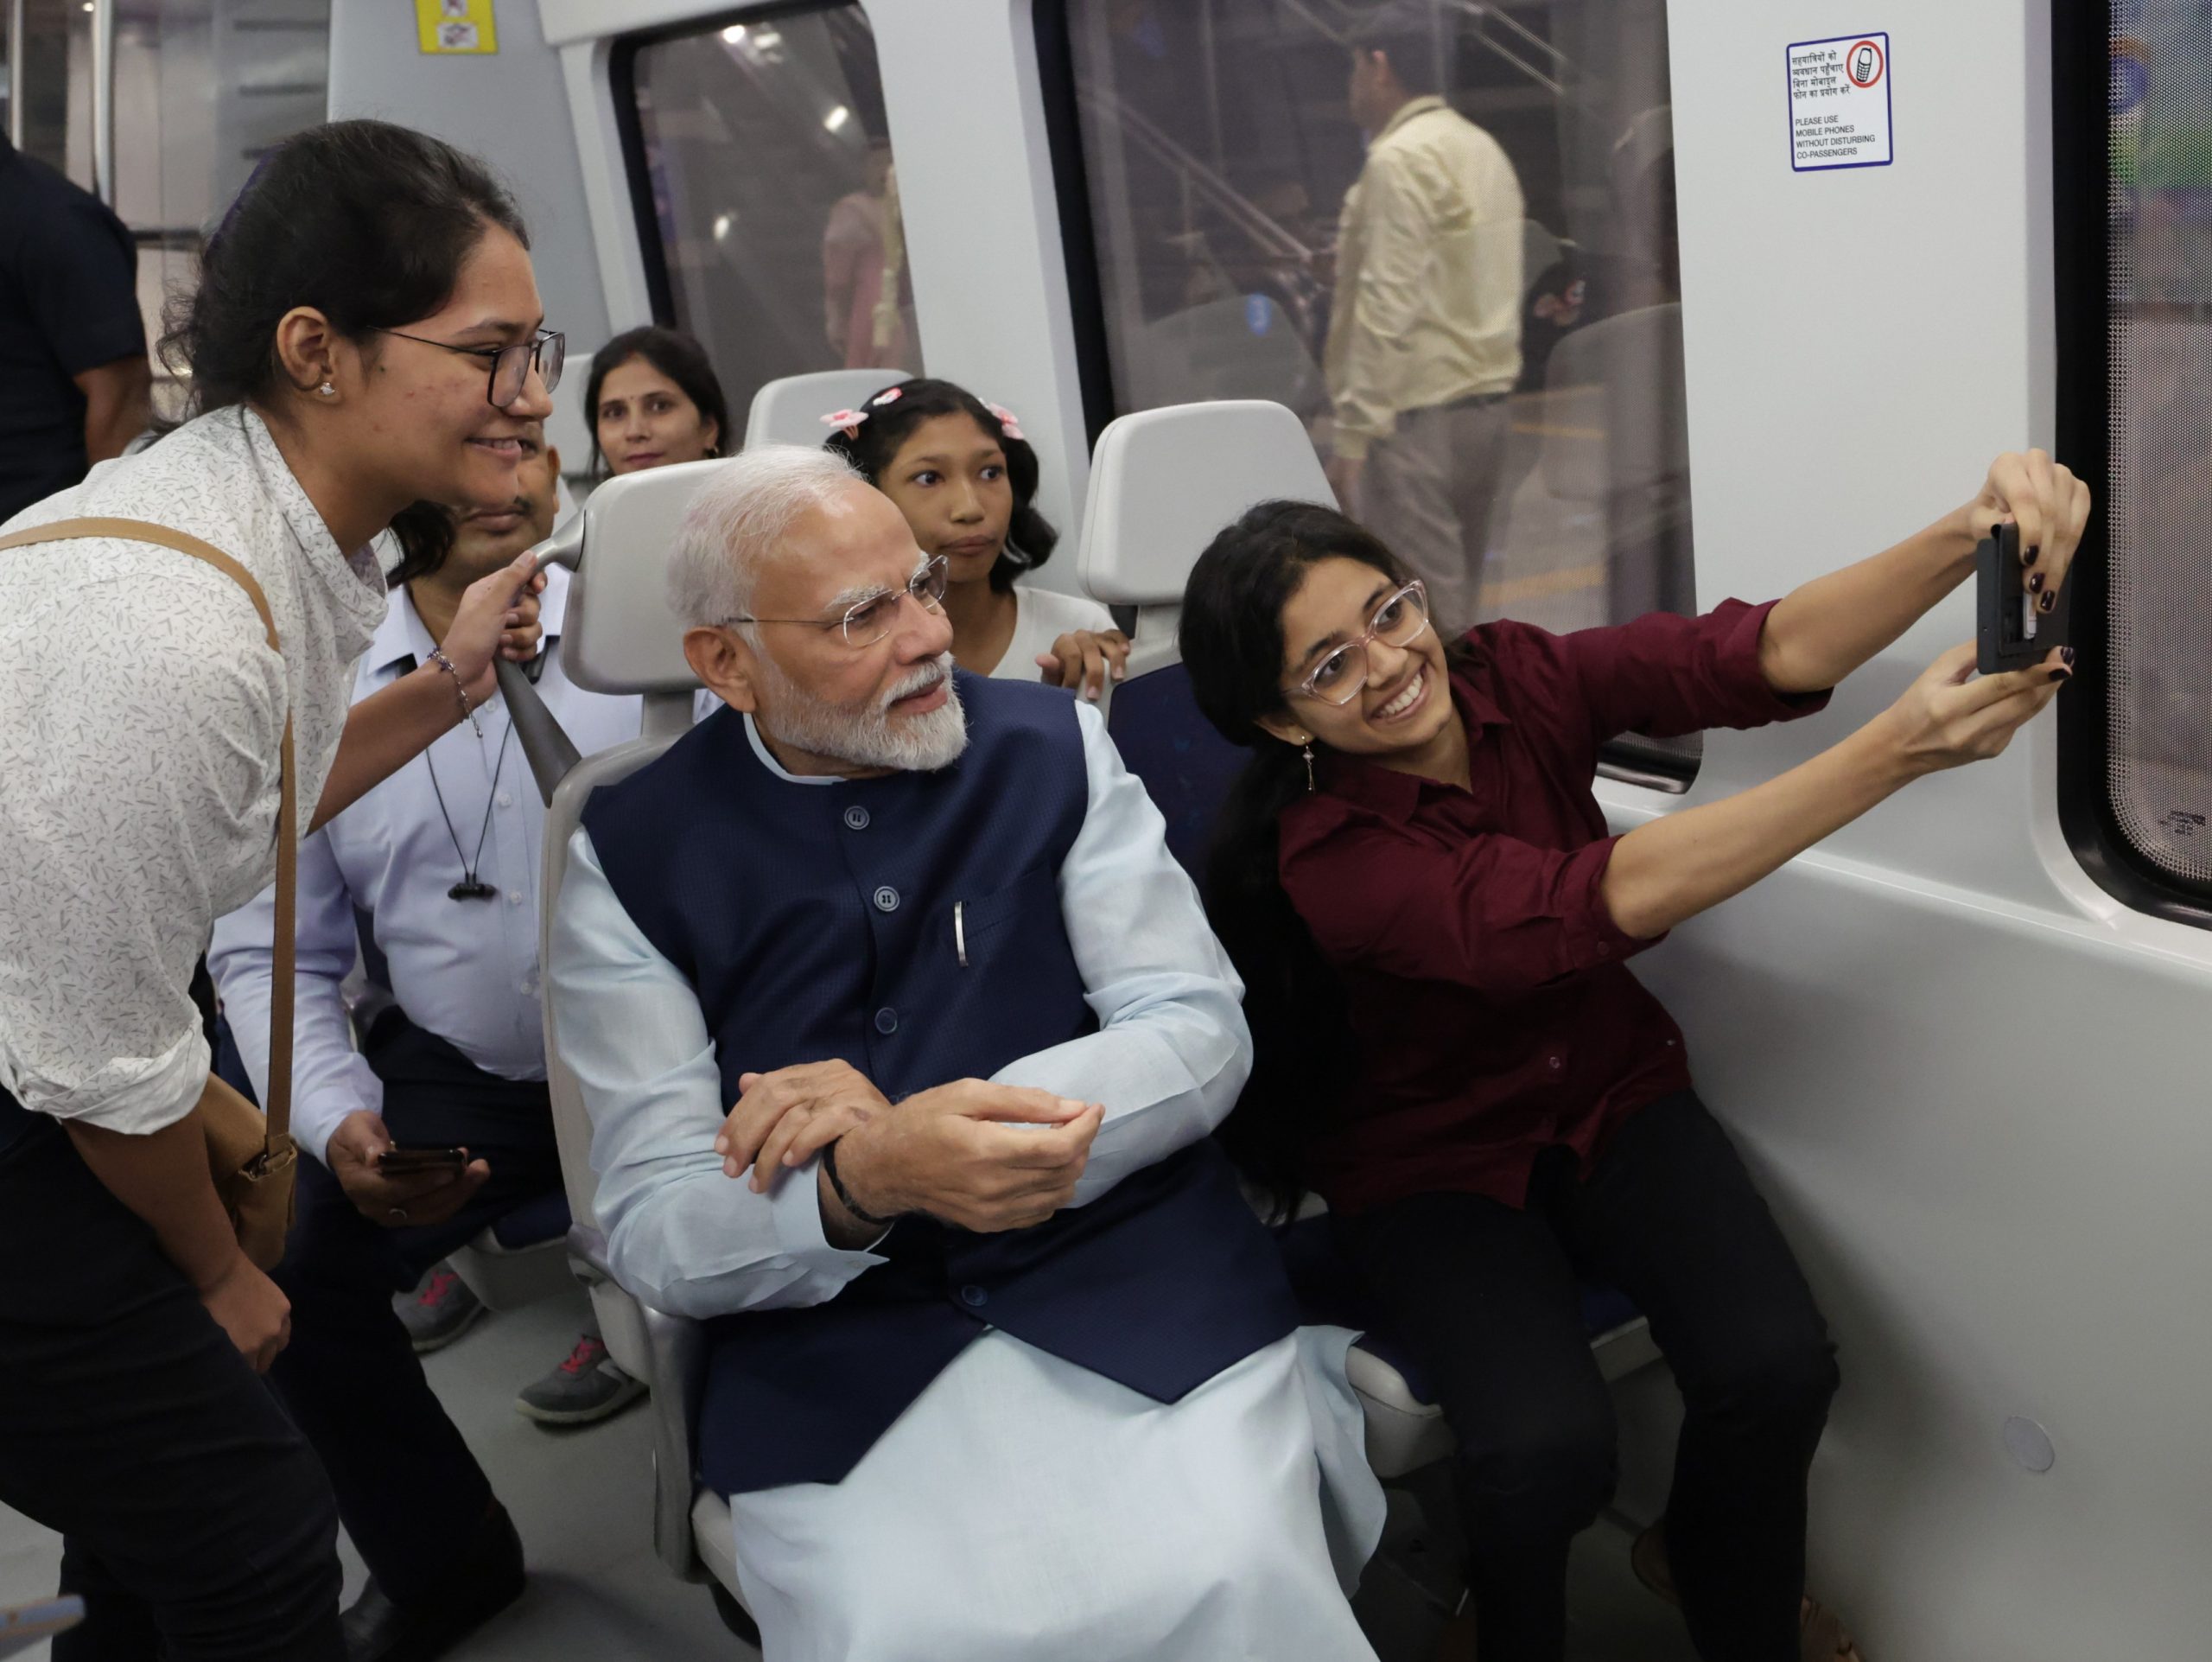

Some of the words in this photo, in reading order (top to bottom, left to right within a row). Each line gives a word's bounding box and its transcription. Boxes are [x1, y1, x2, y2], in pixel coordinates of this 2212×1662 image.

[1828, 50, 1836, 60] को
[1792, 67, 1818, 76] व्यवधान
[1792, 78, 1808, 88] बिना
[1811, 76, 1836, 86] मोबाइल
[1793, 89, 1807, 99] फोन
[1820, 86, 1838, 97] प्रयोग
[1840, 84, 1850, 94] करें
[1796, 116, 1822, 126] PLEASE
[1824, 115, 1839, 124] USE
[1796, 128, 1823, 137] MOBILE
[1825, 125, 1854, 135] PHONES
[1796, 138, 1829, 148] WITHOUT
[1830, 135, 1875, 146] DISTURBING
[1797, 148, 1857, 159] CO-PASSENGERS
